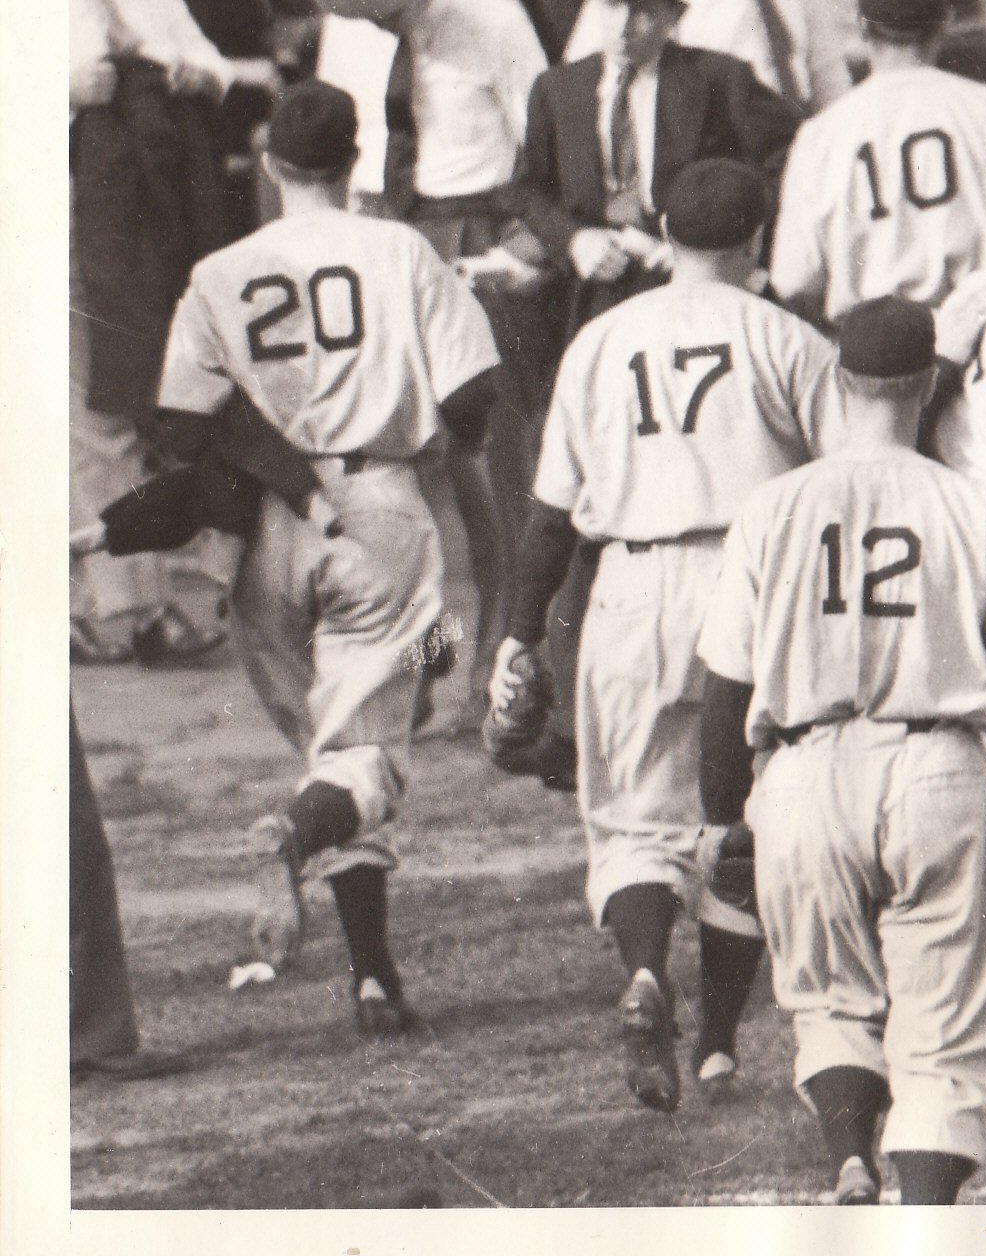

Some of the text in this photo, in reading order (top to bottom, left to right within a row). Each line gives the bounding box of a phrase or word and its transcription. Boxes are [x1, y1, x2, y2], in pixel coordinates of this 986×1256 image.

[856, 129, 958, 220] 10
[241, 265, 364, 361] 20
[628, 344, 734, 436] 17
[821, 524, 922, 617] 12
